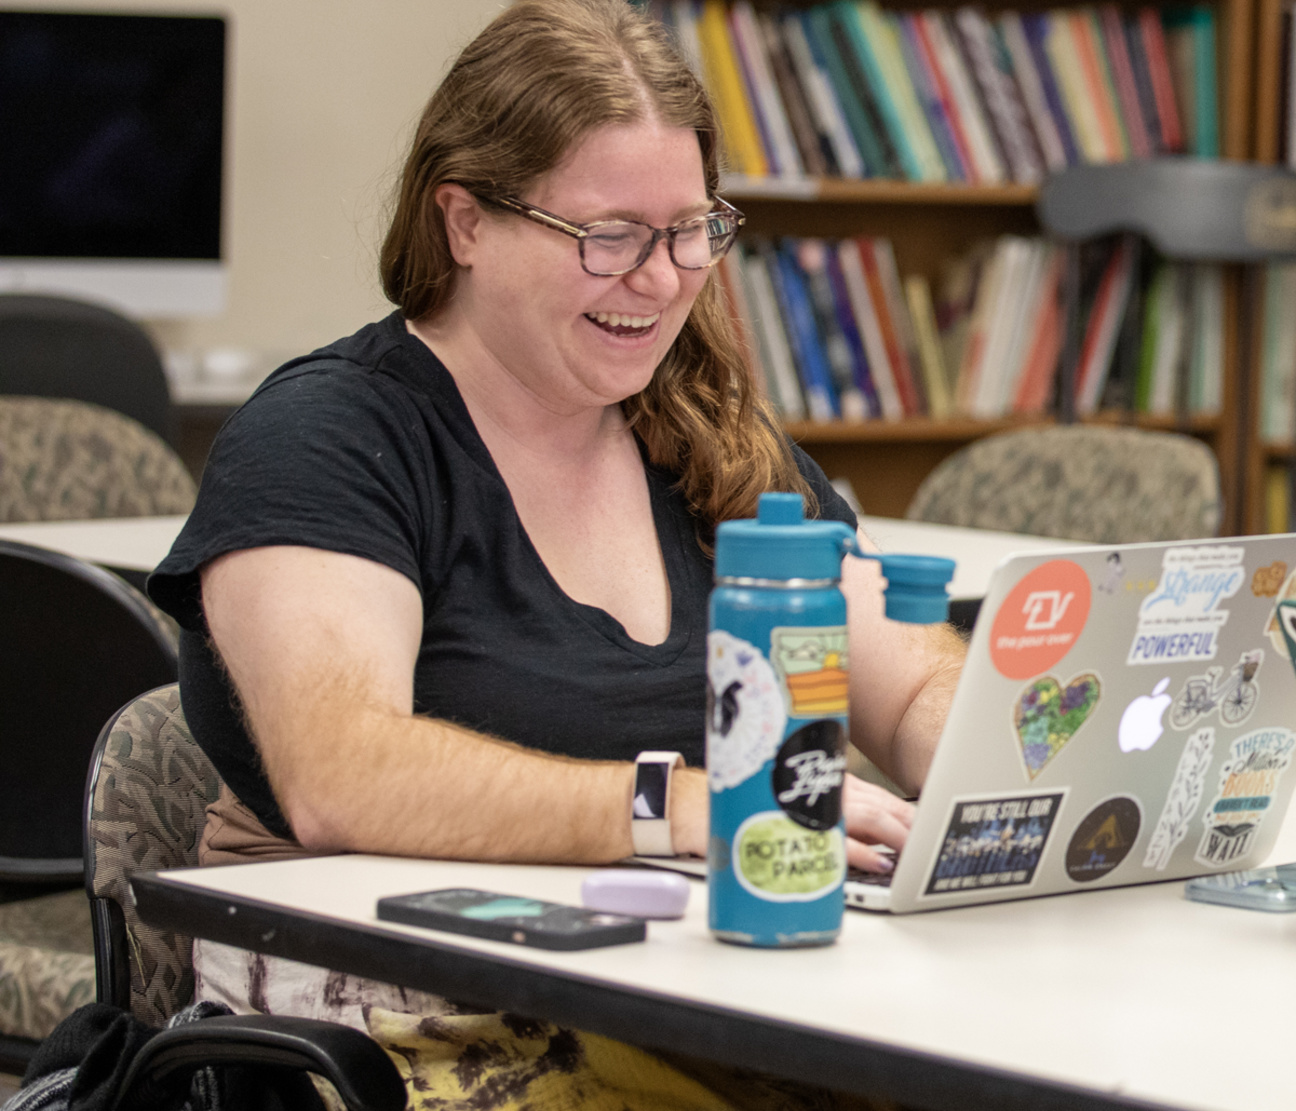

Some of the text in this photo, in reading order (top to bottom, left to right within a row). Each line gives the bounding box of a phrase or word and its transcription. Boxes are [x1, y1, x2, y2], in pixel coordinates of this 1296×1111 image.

[1132, 632, 1215, 659] POWERFUL
[961, 797, 1054, 824] YOU'RE STILL OUR
[745, 835, 831, 859] POTATO
